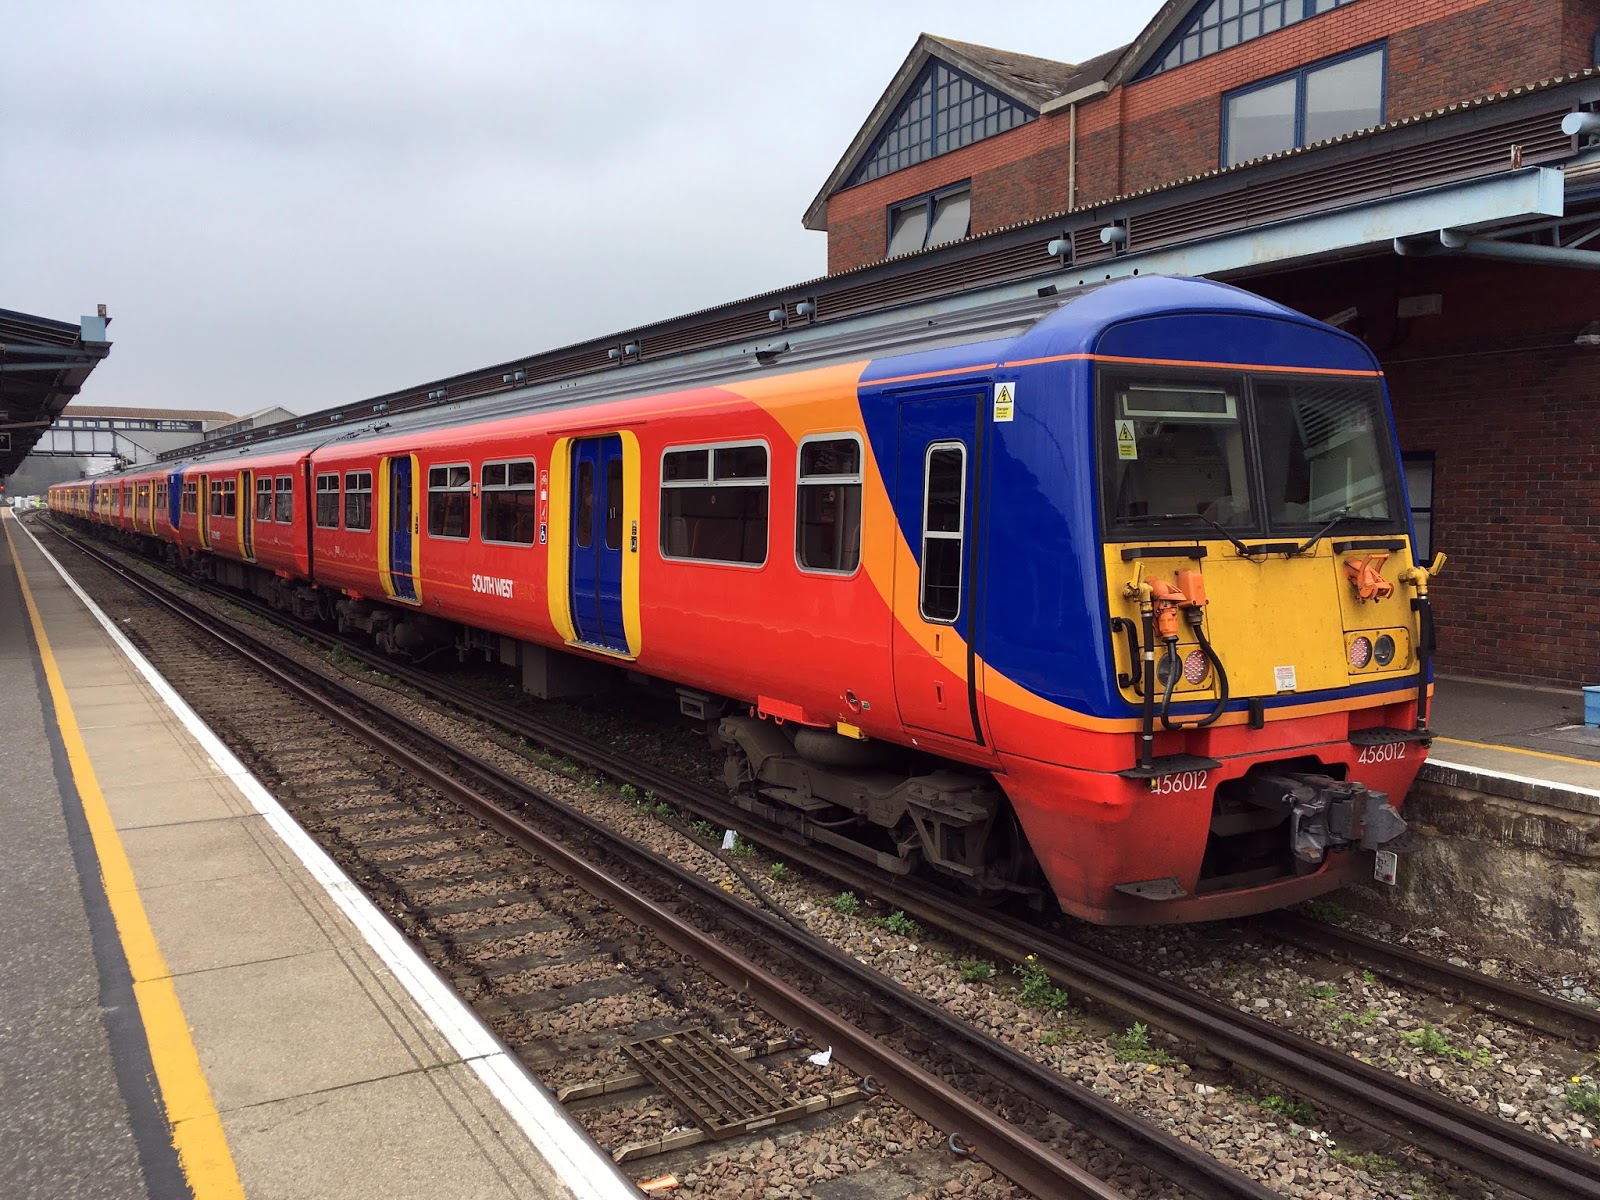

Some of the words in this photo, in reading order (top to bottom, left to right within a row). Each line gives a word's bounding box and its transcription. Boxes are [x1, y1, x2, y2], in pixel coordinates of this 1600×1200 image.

[471, 573, 495, 595] SOUTH
[494, 577, 513, 598] WEST
[1357, 741, 1406, 764] 456012
[1150, 769, 1208, 795] 456012
